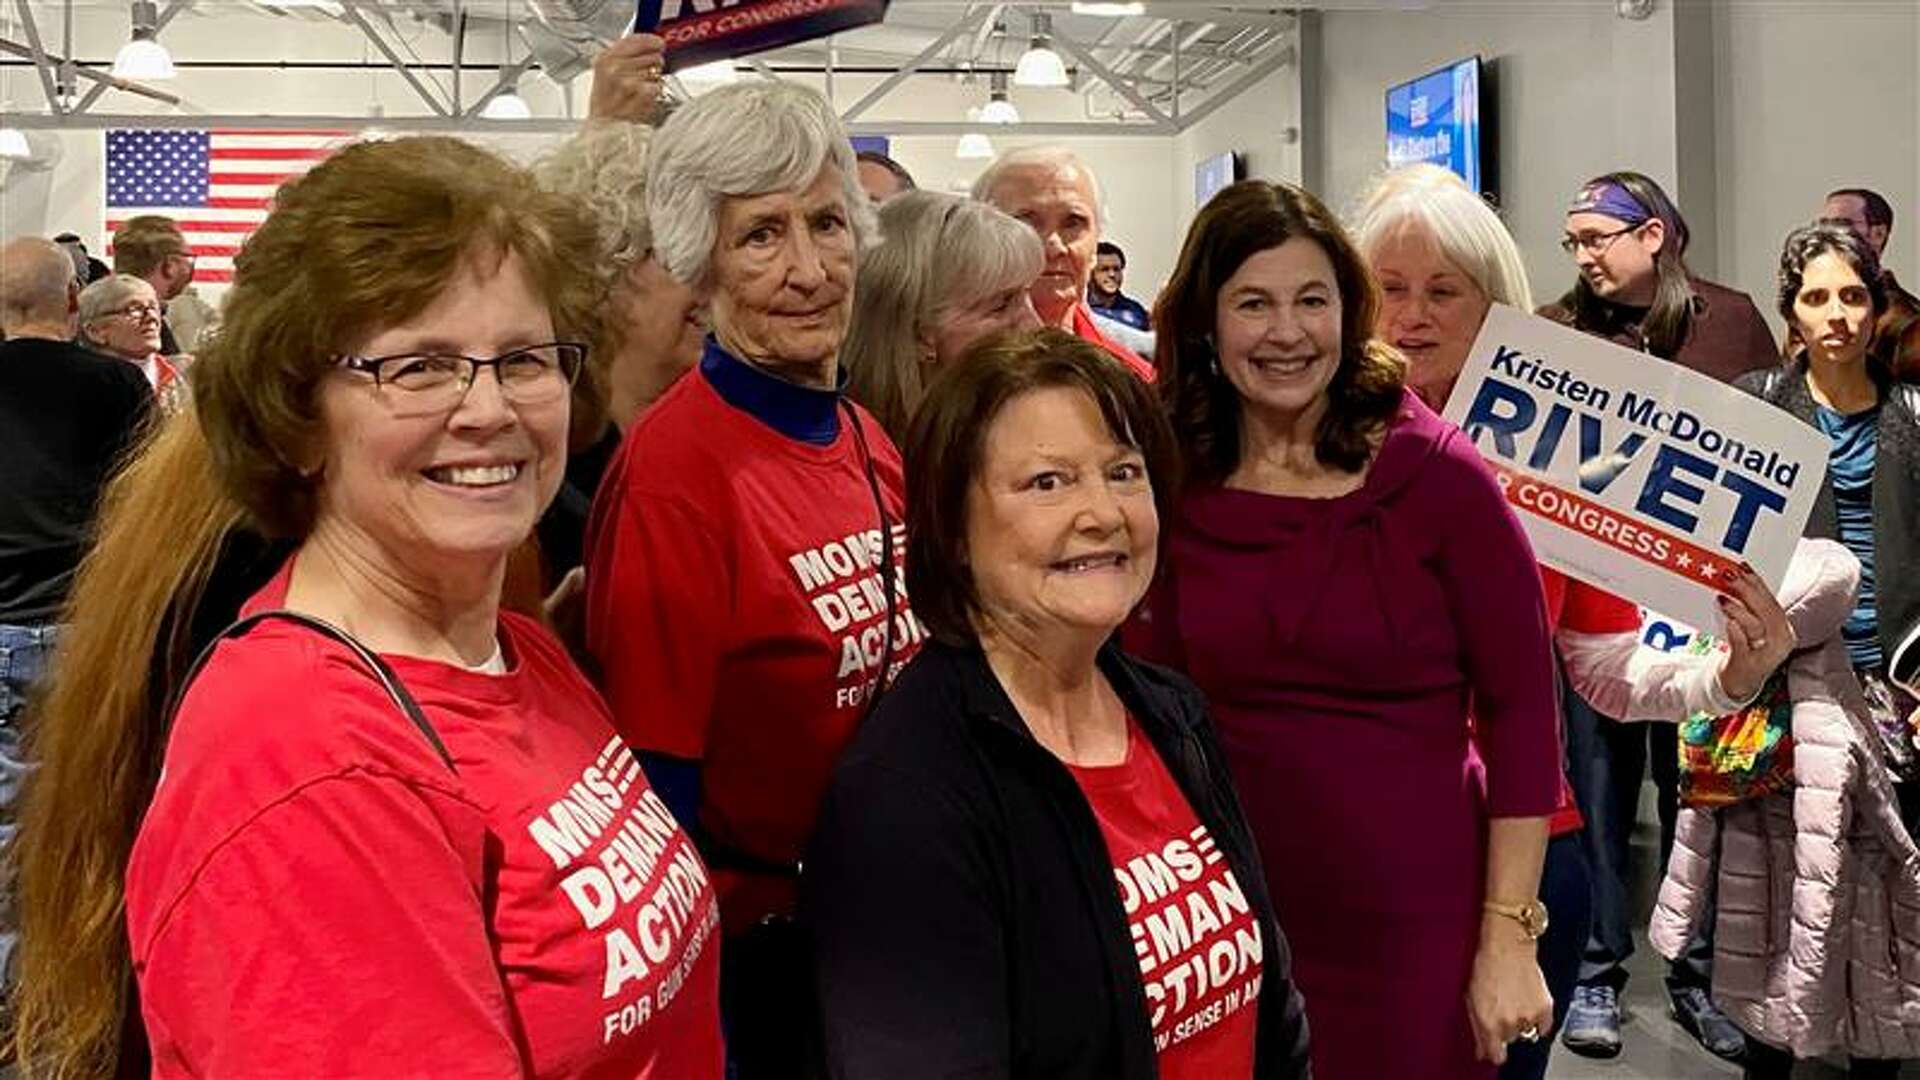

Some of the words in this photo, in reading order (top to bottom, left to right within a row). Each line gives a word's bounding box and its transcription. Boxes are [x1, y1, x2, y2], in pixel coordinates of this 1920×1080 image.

[664, 20, 713, 43] FOR
[1464, 377, 1786, 555] RIVET
[1491, 345, 1610, 411] Kristen
[1617, 392, 1800, 489] McDonald
[1519, 484, 1671, 560] CONGRESS
[528, 766, 623, 869] MOMS
[560, 789, 679, 930] DEMAND
[602, 843, 708, 999] ACTION
[1113, 839, 1203, 914] OMS
[1130, 870, 1249, 973] EMAN
[603, 995, 652, 1044] FOR
[1145, 918, 1263, 1028] CTION
[1173, 1000, 1222, 1044] SENSE
